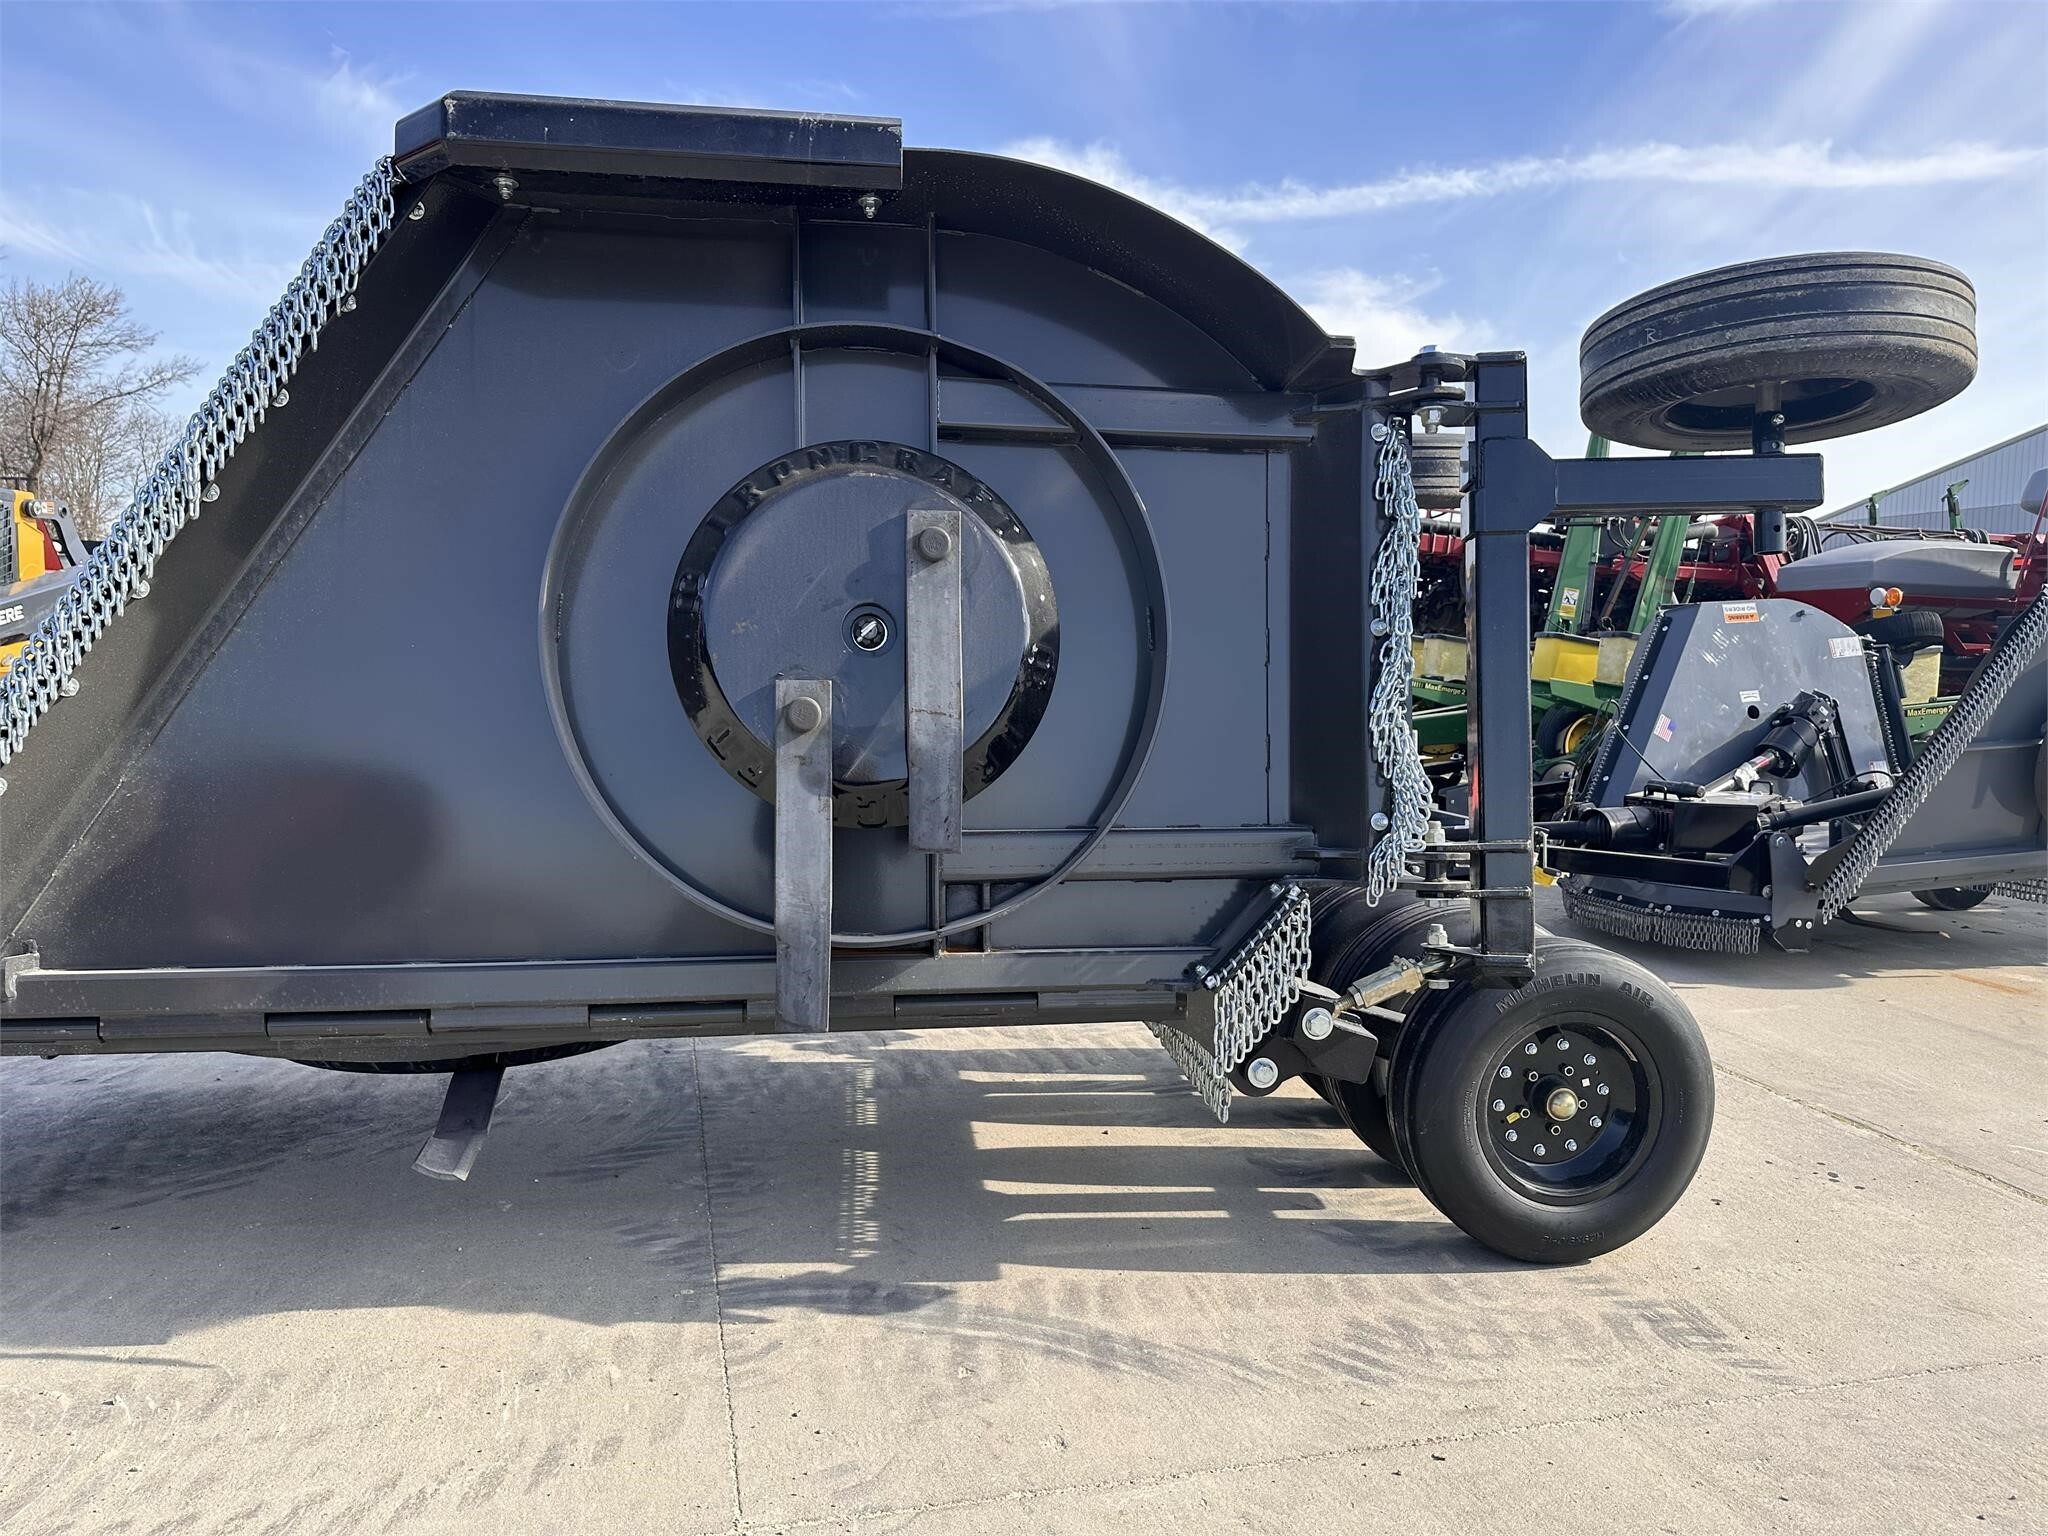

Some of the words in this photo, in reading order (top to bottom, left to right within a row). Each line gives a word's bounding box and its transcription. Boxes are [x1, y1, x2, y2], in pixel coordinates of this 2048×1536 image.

[1425, 682, 1461, 695] MaxEmerge
[1907, 706, 1948, 717] MaxEmerge
[1496, 973, 1601, 1014] MICHELIN
